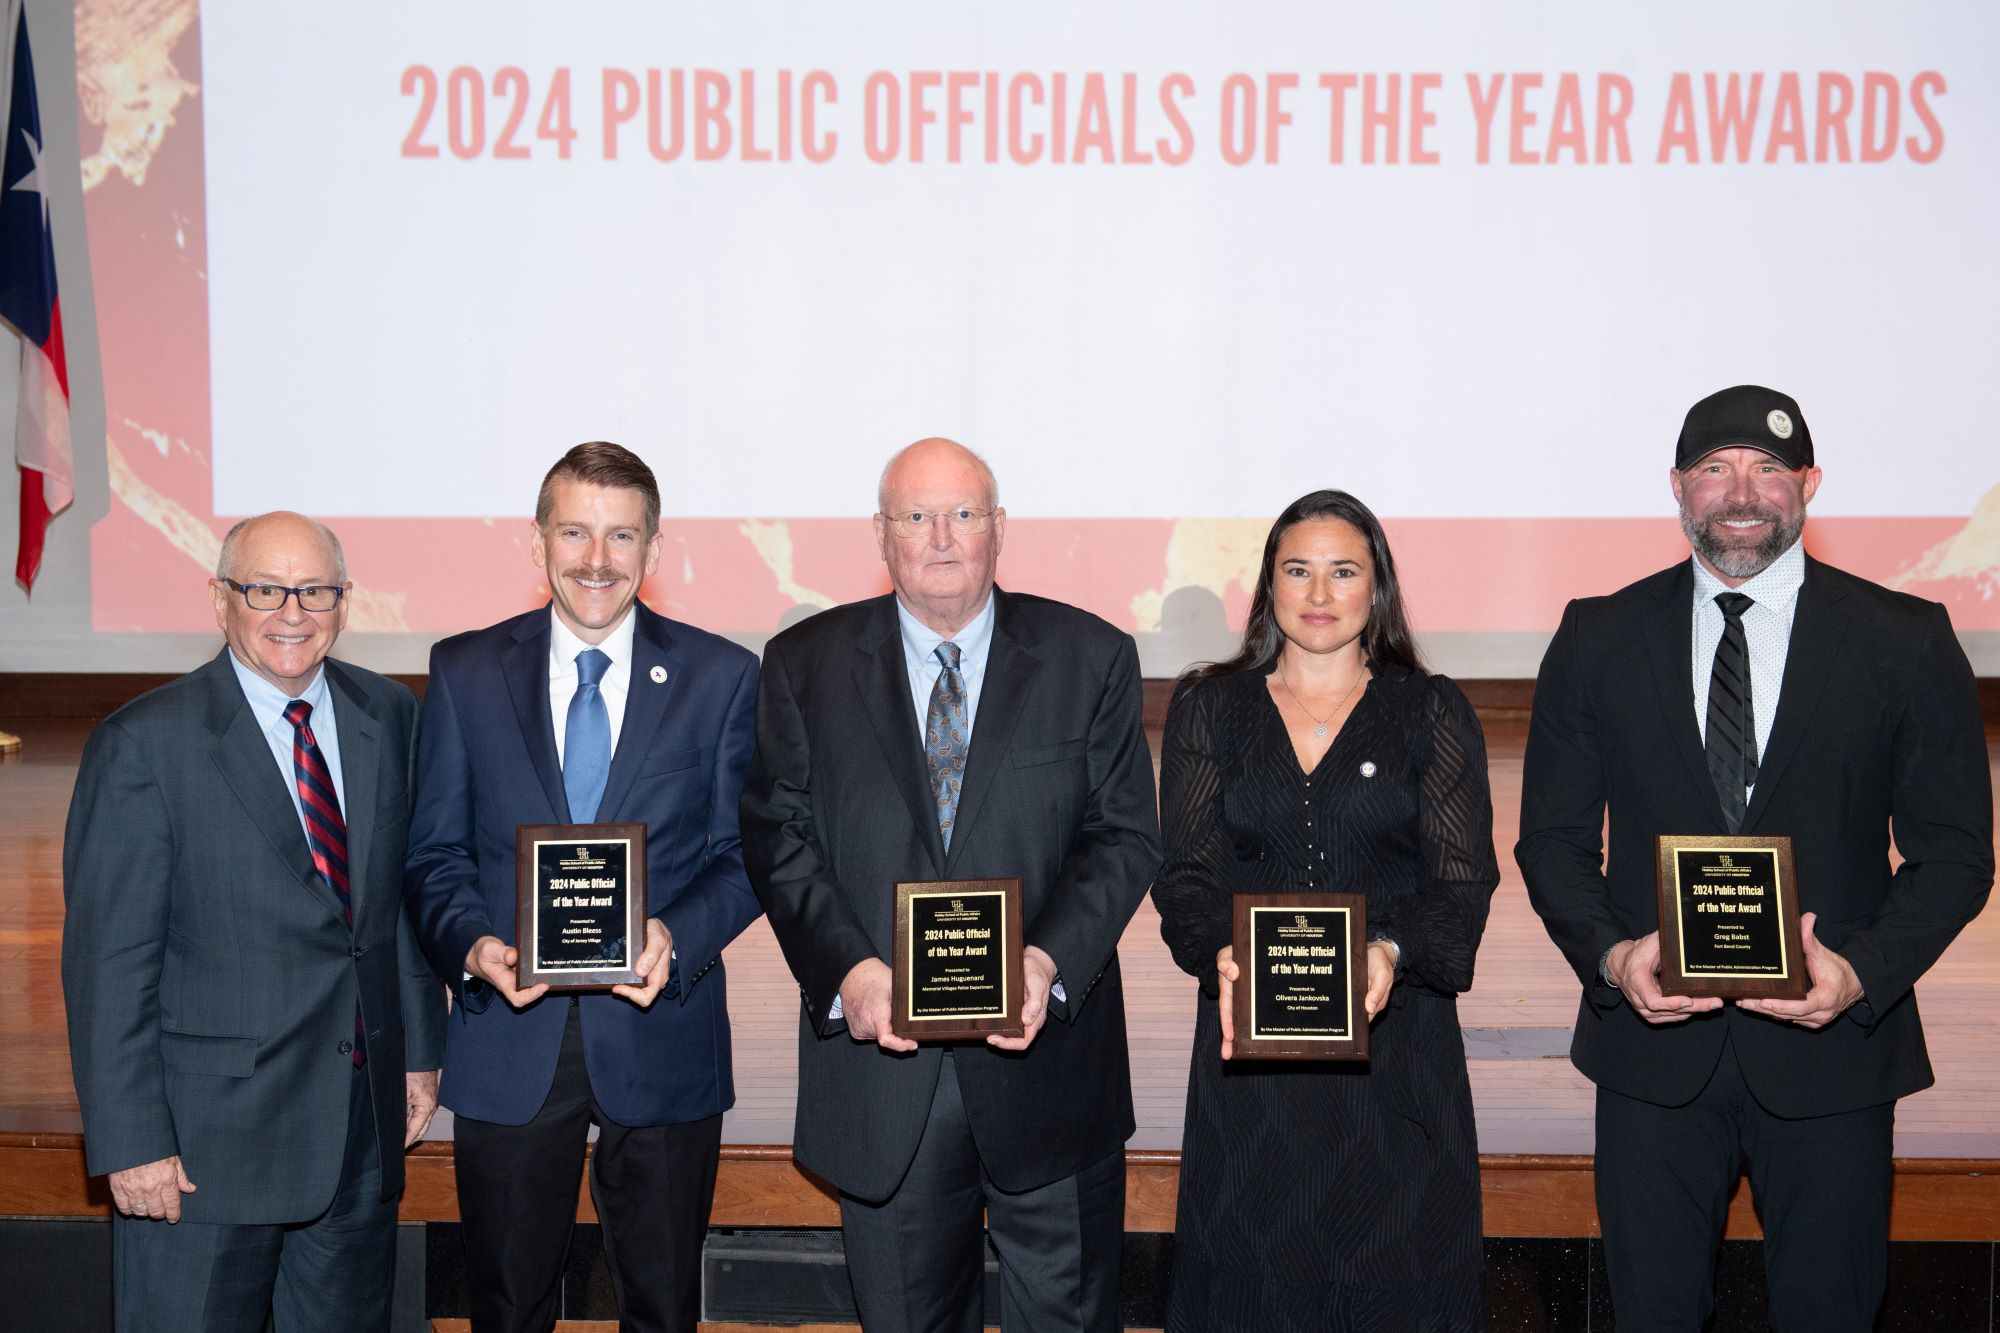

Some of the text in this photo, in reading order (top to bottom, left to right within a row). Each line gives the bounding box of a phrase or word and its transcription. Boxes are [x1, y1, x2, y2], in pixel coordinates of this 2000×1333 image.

[400, 64, 1948, 167] 2024 PUBLIC OFFICIALS OF THE YEAR AWARDS
[550, 878, 616, 889] 2024 Public Official
[1693, 885, 1764, 895] 2024 Public Official
[553, 896, 612, 907] of the Year Award
[1698, 903, 1762, 913] of the Year Award
[925, 928, 990, 940] 2024 Public Official
[928, 946, 987, 957] of the Year Award
[1268, 946, 1335, 956] 2024 Public Official
[1271, 964, 1332, 974] of the Year Award
